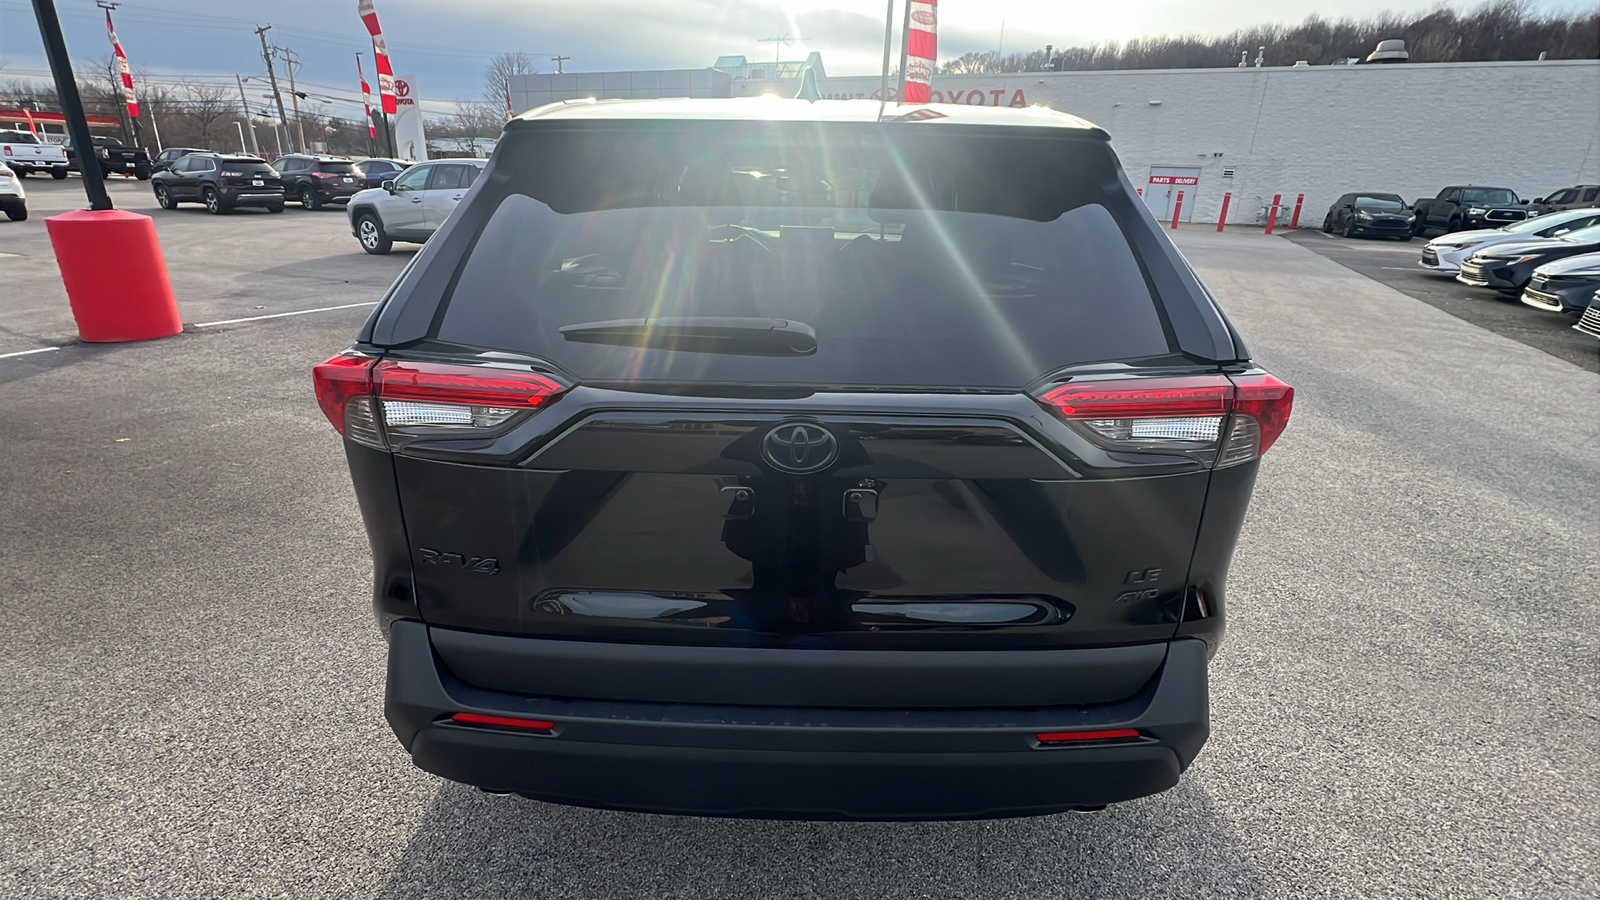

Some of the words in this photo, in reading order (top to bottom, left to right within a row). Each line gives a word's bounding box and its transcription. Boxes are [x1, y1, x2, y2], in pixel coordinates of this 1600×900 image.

[931, 89, 1027, 107] OYOTA
[419, 547, 500, 576] RAV4
[1123, 568, 1162, 585] LE
[1114, 588, 1159, 603] AWD
